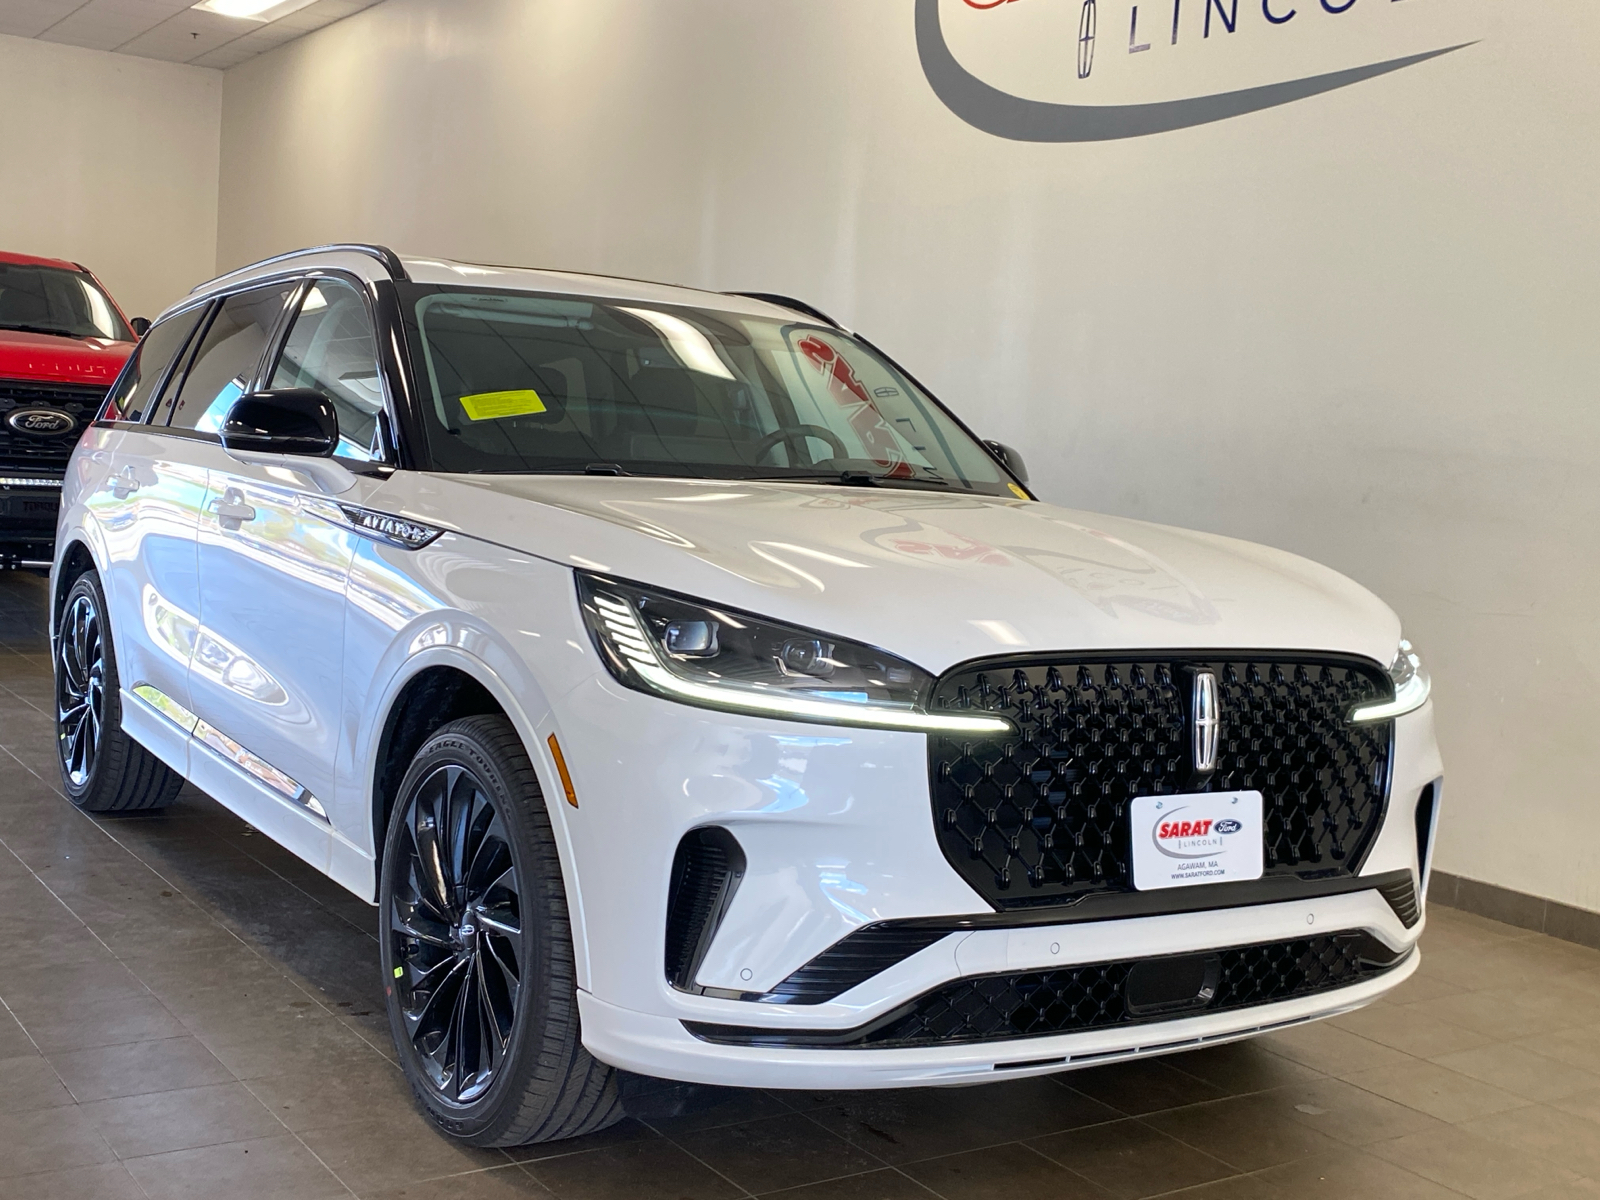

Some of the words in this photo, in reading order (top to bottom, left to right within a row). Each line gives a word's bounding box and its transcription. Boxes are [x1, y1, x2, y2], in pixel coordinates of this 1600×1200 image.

[1129, 0, 1411, 54] LINC
[25, 414, 60, 430] Ford
[363, 515, 422, 541] AVIATOR
[429, 740, 465, 754] EAGLE
[469, 748, 512, 820] TOURING
[1158, 819, 1213, 839] SARAT
[1217, 820, 1238, 833] Ford
[1184, 839, 1218, 847] LINCOLN
[1171, 869, 1225, 879] WWW.SARATFORD.COM
[1177, 861, 1207, 871] AGAWAM,
[1208, 860, 1219, 868] MA
